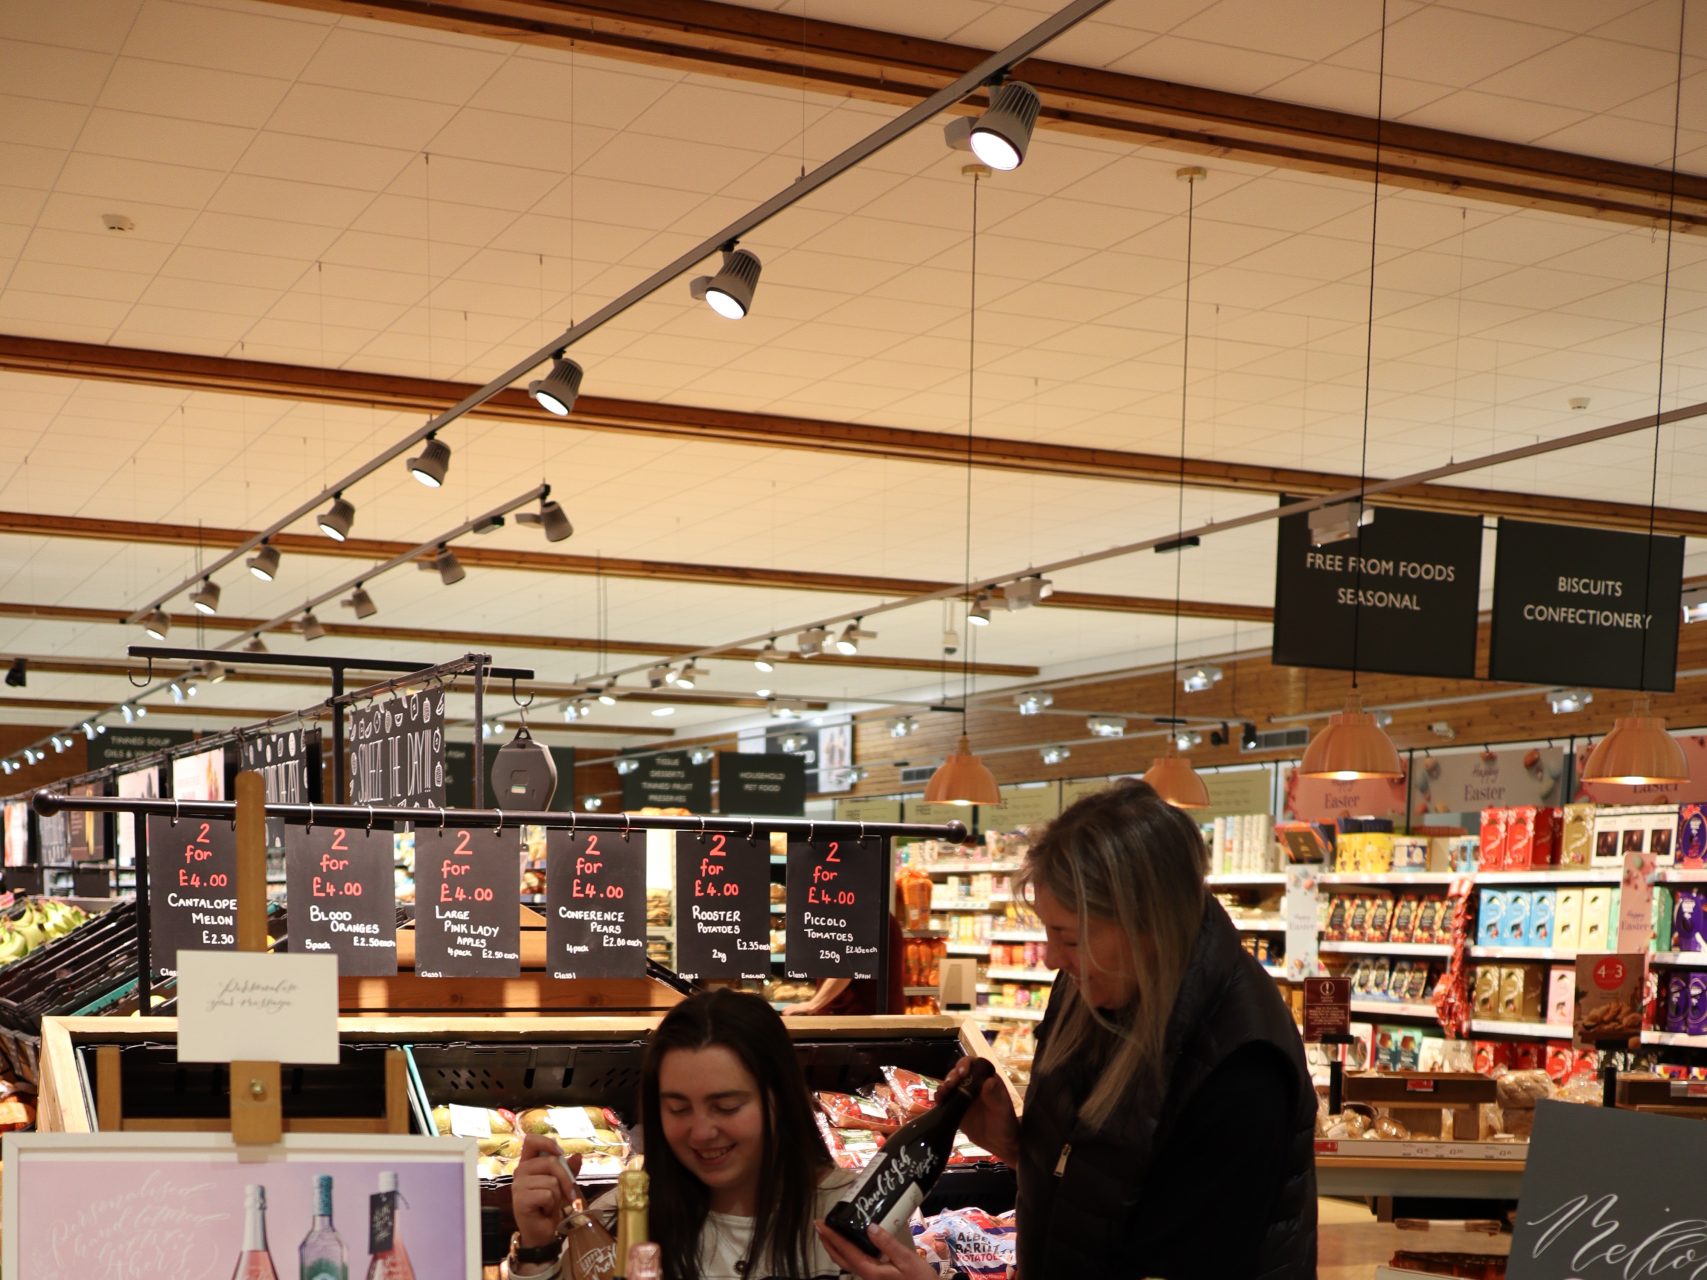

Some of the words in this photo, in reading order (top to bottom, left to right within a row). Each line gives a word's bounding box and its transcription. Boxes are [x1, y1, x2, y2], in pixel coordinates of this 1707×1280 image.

[1306, 552, 1343, 572] FREE
[1348, 557, 1394, 577] FROM
[1399, 562, 1455, 582] FOODS
[1557, 576, 1622, 598] BISCUITS
[1337, 587, 1420, 611] SEASONAL
[1523, 604, 1653, 630] CONFECTIONERY
[1324, 792, 1360, 809] Easter
[1464, 784, 1506, 801] Easter
[196, 823, 210, 843] 2
[331, 828, 348, 850] 2
[453, 830, 473, 855] 2
[586, 835, 600, 856] 2
[710, 835, 726, 857] 2
[185, 845, 212, 863] for
[826, 842, 841, 862] 2
[320, 854, 349, 872] for
[442, 859, 470, 879] for
[576, 858, 603, 875] for
[700, 858, 724, 877] for
[178, 870, 228, 887] £4.00
[813, 866, 838, 883] for
[312, 877, 363, 897] £4.00
[440, 884, 493, 903] £4.00
[572, 879, 624, 899] £4.00
[695, 880, 739, 897] £4.00
[808, 887, 855, 905] £4.00
[192, 912, 233, 926] MELON
[310, 905, 352, 922] BLOOD
[435, 905, 470, 920] LARGE
[559, 907, 625, 922] CONFERENCE
[692, 906, 741, 922] ROOSTER
[804, 912, 847, 927] PICCOLO
[330, 921, 380, 934] ORANGES
[444, 921, 468, 934] PINK
[469, 924, 499, 938] LADY
[590, 922, 622, 934] PEARS
[697, 922, 740, 934] POTATOES
[804, 928, 854, 942] TOMATOES
[202, 930, 235, 945] £2.30
[457, 936, 486, 948] APPLES
[160, 968, 179, 978] Clas
[1615, 969, 1623, 977] 3
